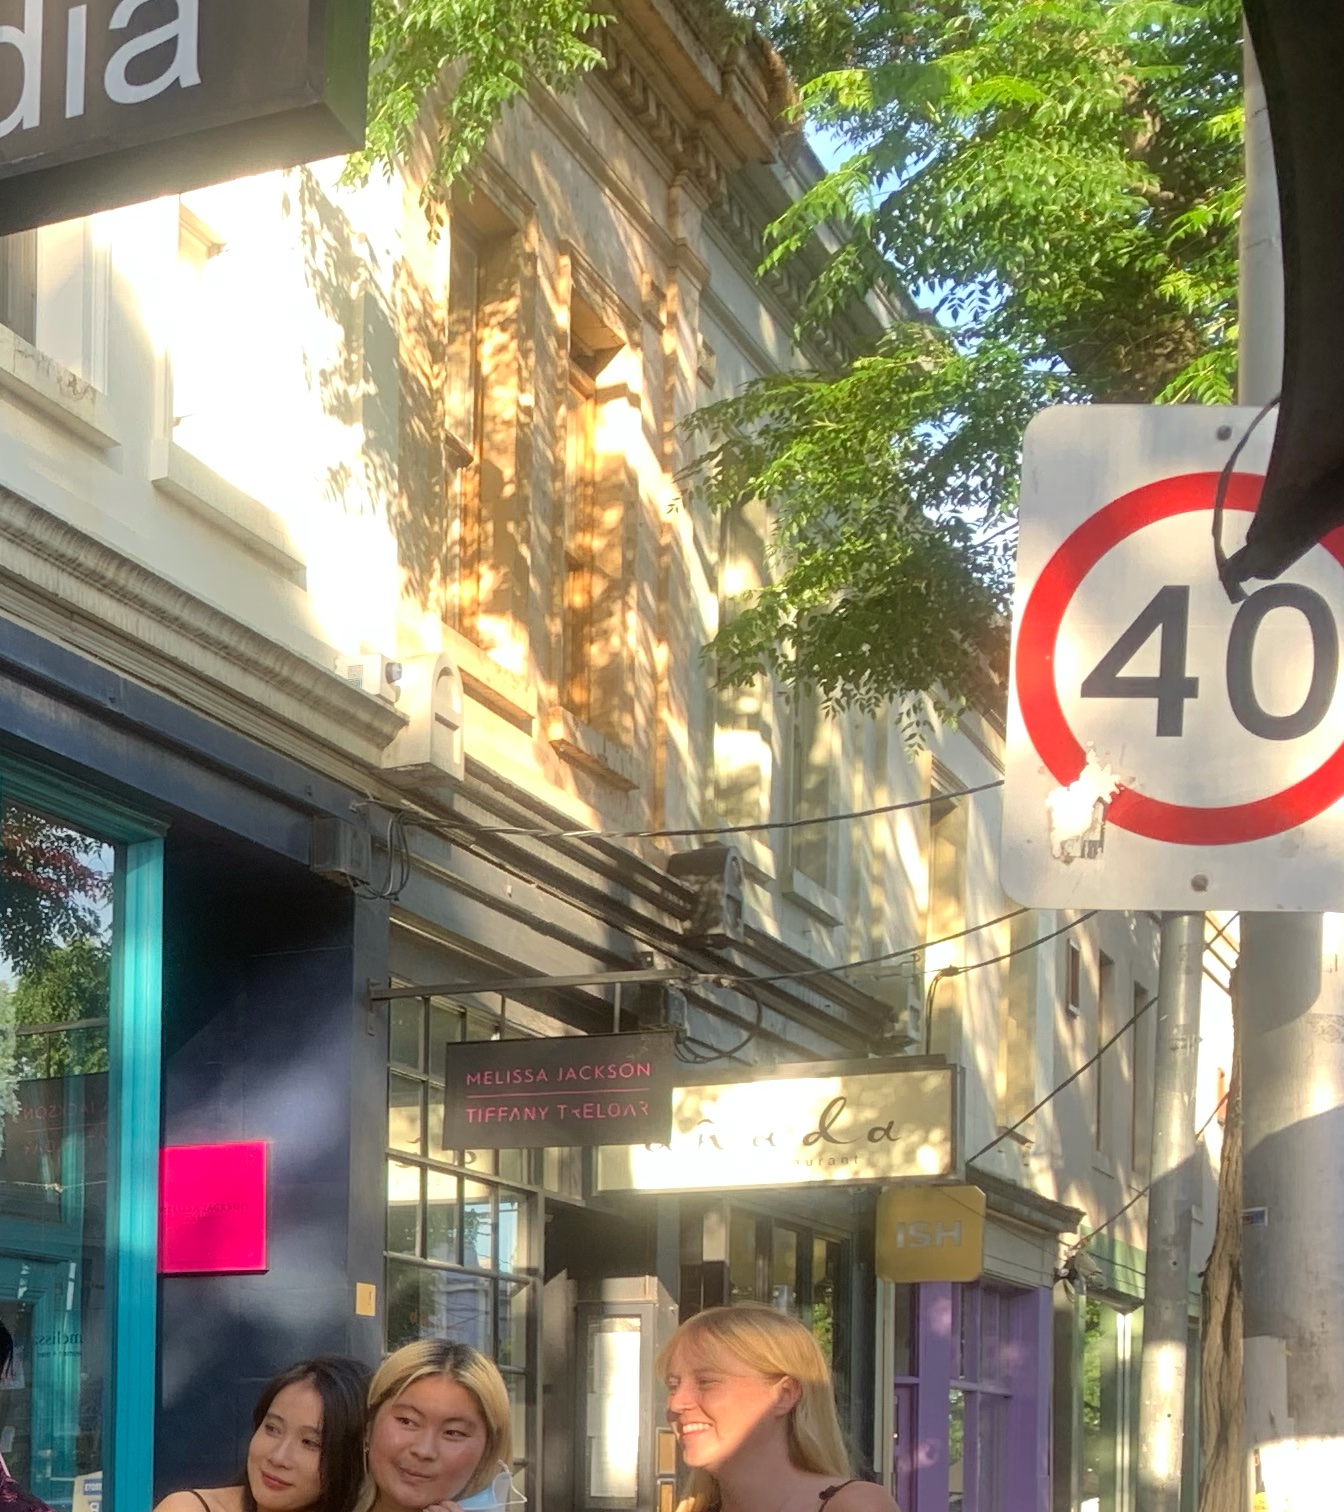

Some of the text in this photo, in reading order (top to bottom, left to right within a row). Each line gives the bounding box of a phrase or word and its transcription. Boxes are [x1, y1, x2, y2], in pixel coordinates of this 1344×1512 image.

[1080, 582, 1339, 741] 40
[466, 1062, 651, 1086] MELISSA JACKSON
[466, 1105, 549, 1123] TIFFANY
[896, 1221, 962, 1249] ISH
